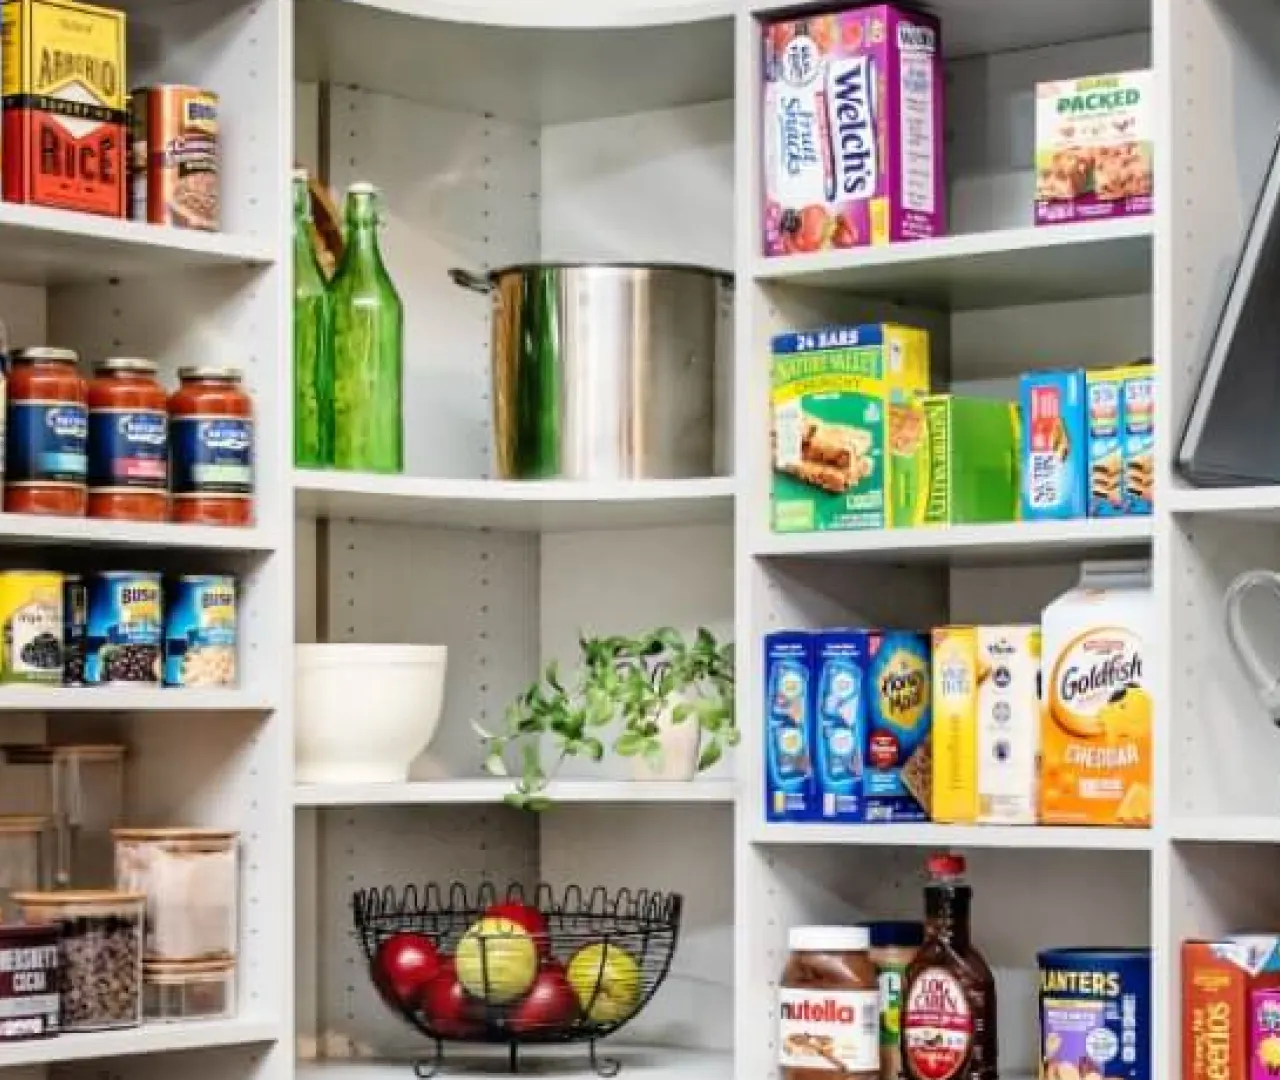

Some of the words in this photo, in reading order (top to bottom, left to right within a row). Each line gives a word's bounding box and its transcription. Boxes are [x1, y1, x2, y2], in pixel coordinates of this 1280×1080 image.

[39, 123, 116, 184] RICE
[833, 64, 872, 194] Welch's
[1059, 650, 1144, 704] Goldfish
[779, 998, 855, 1026] nutella
